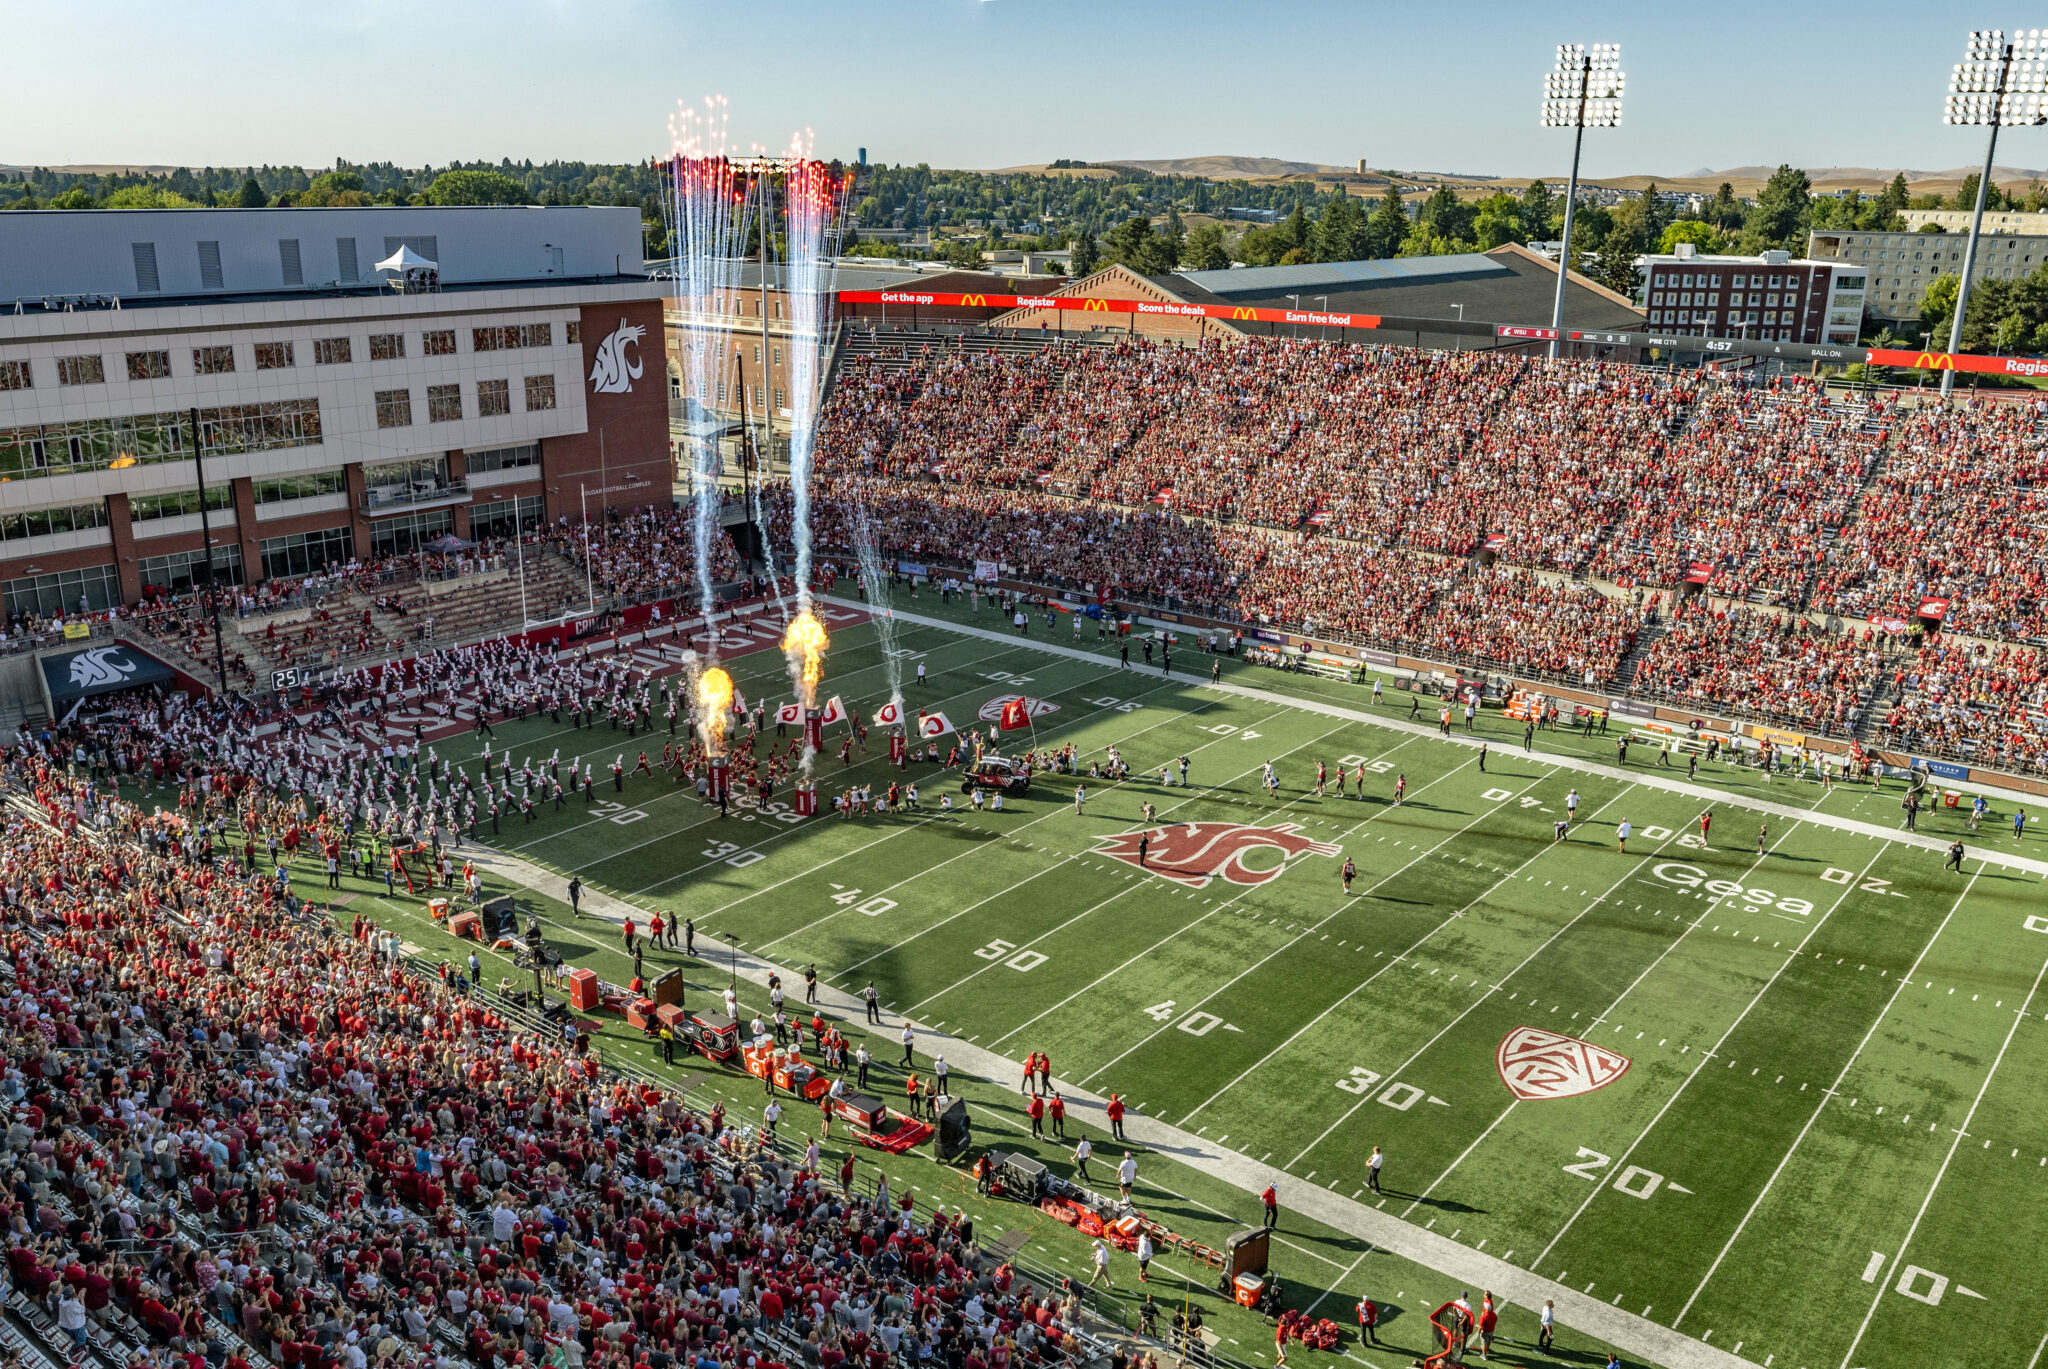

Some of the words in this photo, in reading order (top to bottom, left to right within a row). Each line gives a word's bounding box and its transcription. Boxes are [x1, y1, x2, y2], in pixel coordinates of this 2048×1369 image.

[881, 292, 897, 302] Get
[899, 293, 912, 303] the
[914, 295, 933, 304] app
[1017, 297, 1055, 308] Register
[1138, 302, 1163, 313] Score
[1165, 305, 1178, 314] the
[1180, 305, 1205, 316] deals
[1286, 312, 1307, 322] Earn
[1308, 313, 1325, 323] free
[1327, 314, 1350, 325] food
[1513, 328, 1527, 336] WSU
[1583, 333, 1597, 341] WISC
[1706, 340, 1732, 351] 4:57
[1811, 349, 1828, 357] BALL
[1829, 350, 1842, 358] ON:
[582, 488, 603, 497] OUGAR
[277, 669, 296, 687] 25
[984, 671, 1036, 686] 20
[1090, 696, 1144, 713] 30
[1208, 724, 1262, 742] 40
[1337, 754, 1396, 774] 50
[1481, 788, 1543, 808] 40
[588, 801, 649, 825] 20
[1640, 825, 1708, 850] 30
[701, 842, 767, 867] 30
[1653, 863, 1814, 916] Gesa
[1819, 867, 1893, 896] 20
[830, 888, 898, 917] 40
[1676, 888, 1760, 913] FIELD
[973, 939, 1049, 972] 50
[1143, 999, 1224, 1037] 40
[751, 1061, 760, 1074] G
[775, 1072, 784, 1084] G
[1334, 1066, 1426, 1112] 30
[1562, 1146, 1664, 1200] 20
[1860, 1252, 1949, 1306] 10
[1239, 1288, 1248, 1301] G
